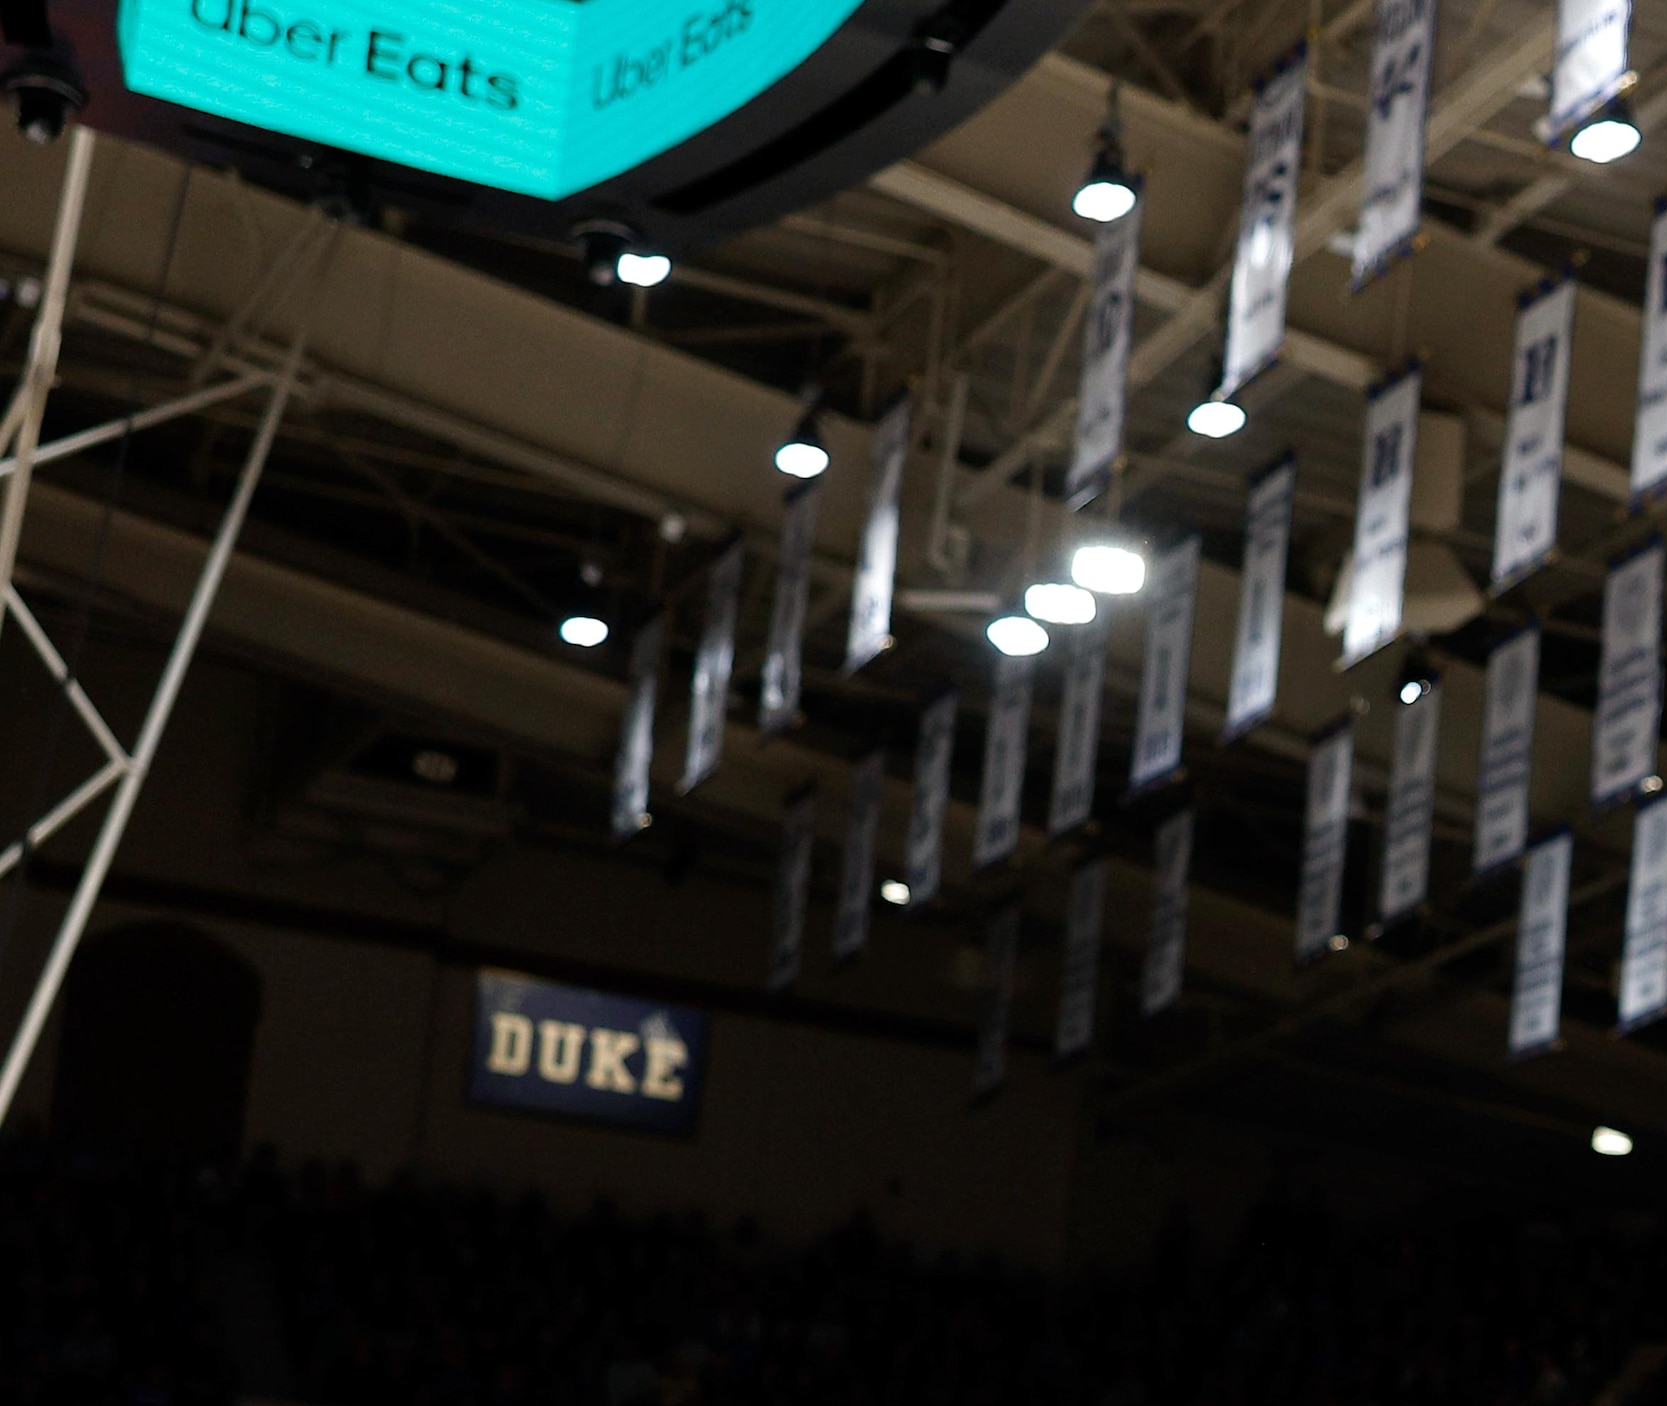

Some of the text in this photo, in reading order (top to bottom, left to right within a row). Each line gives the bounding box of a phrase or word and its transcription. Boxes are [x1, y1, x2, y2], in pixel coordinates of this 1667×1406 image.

[366, 30, 518, 110] Eats
[592, 0, 753, 110] Uber Eats
[487, 1012, 688, 1102] DUKE
